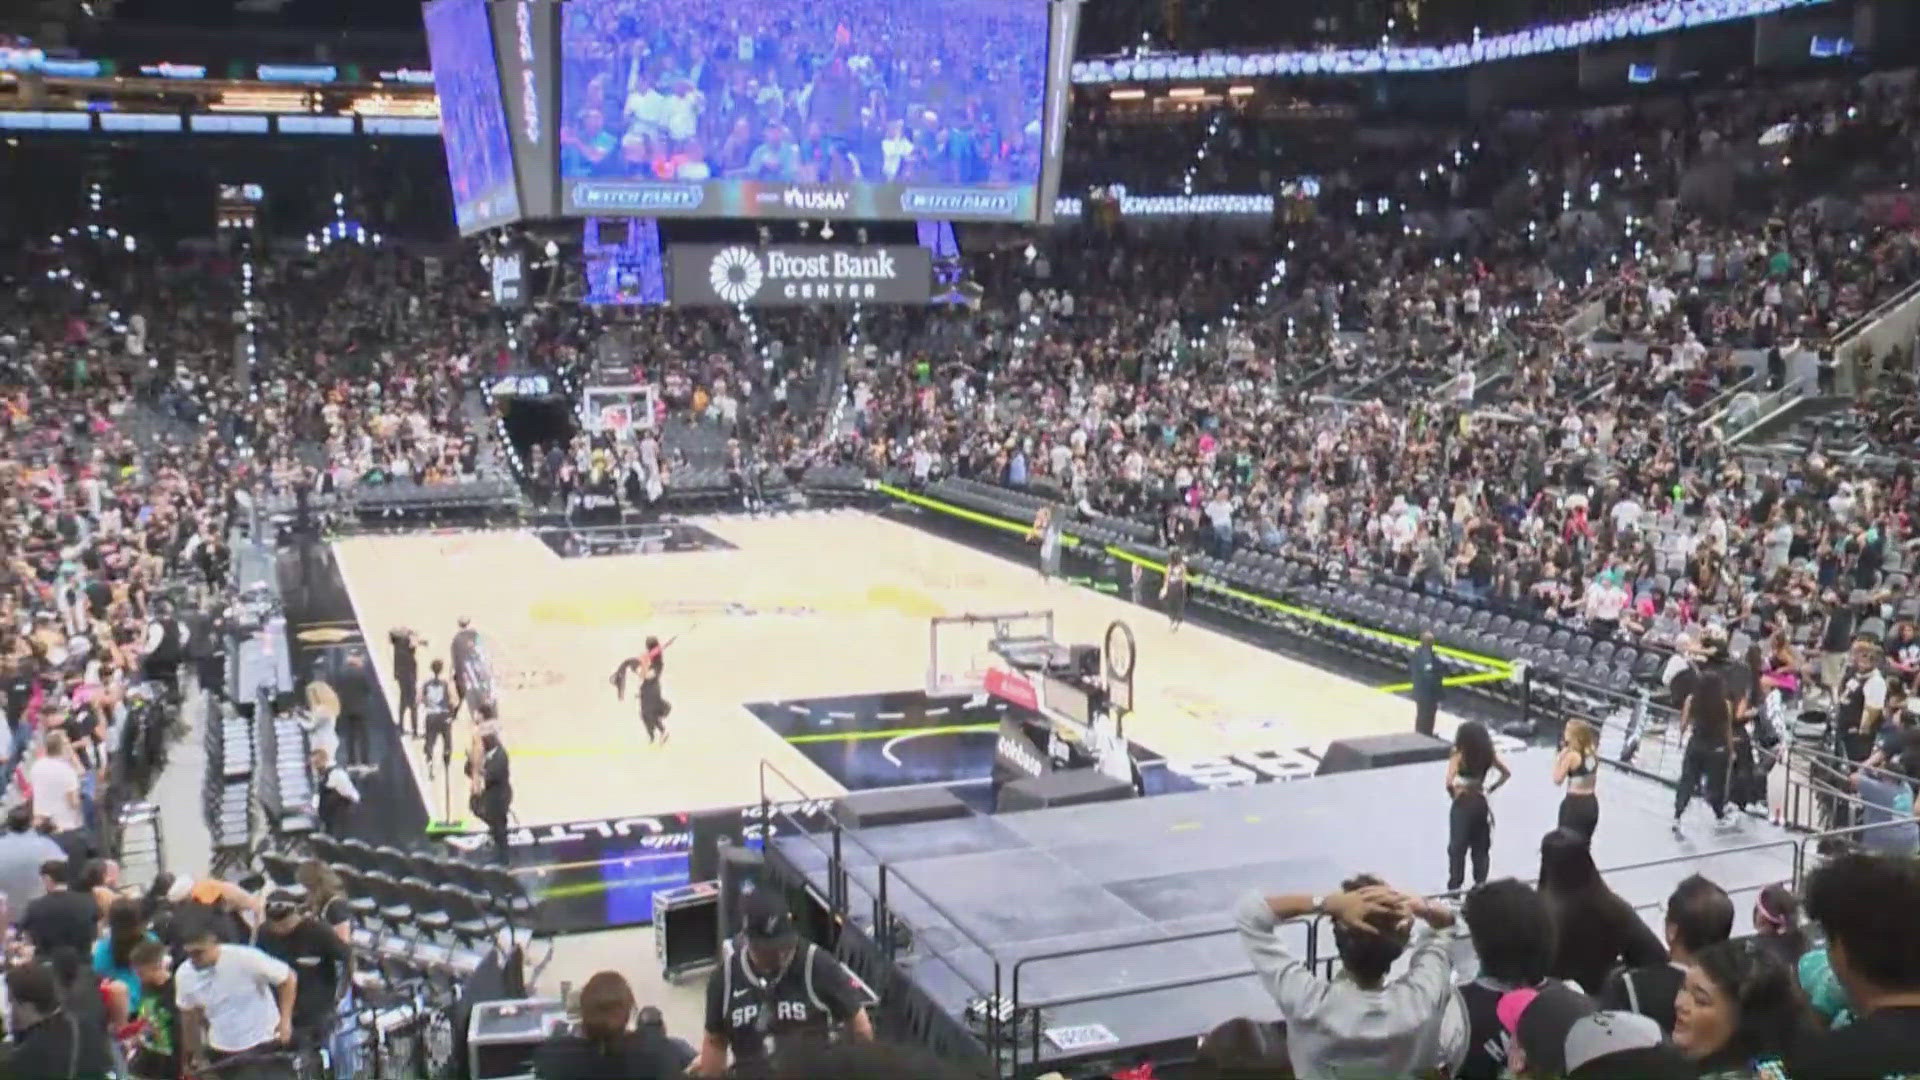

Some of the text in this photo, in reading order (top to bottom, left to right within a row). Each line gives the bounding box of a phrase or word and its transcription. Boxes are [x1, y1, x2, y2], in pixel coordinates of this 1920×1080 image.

[804, 191, 847, 209] USAA
[767, 249, 896, 279] Frost Bank
[783, 283, 876, 299] CENTER
[731, 1000, 807, 1028] SPRS
